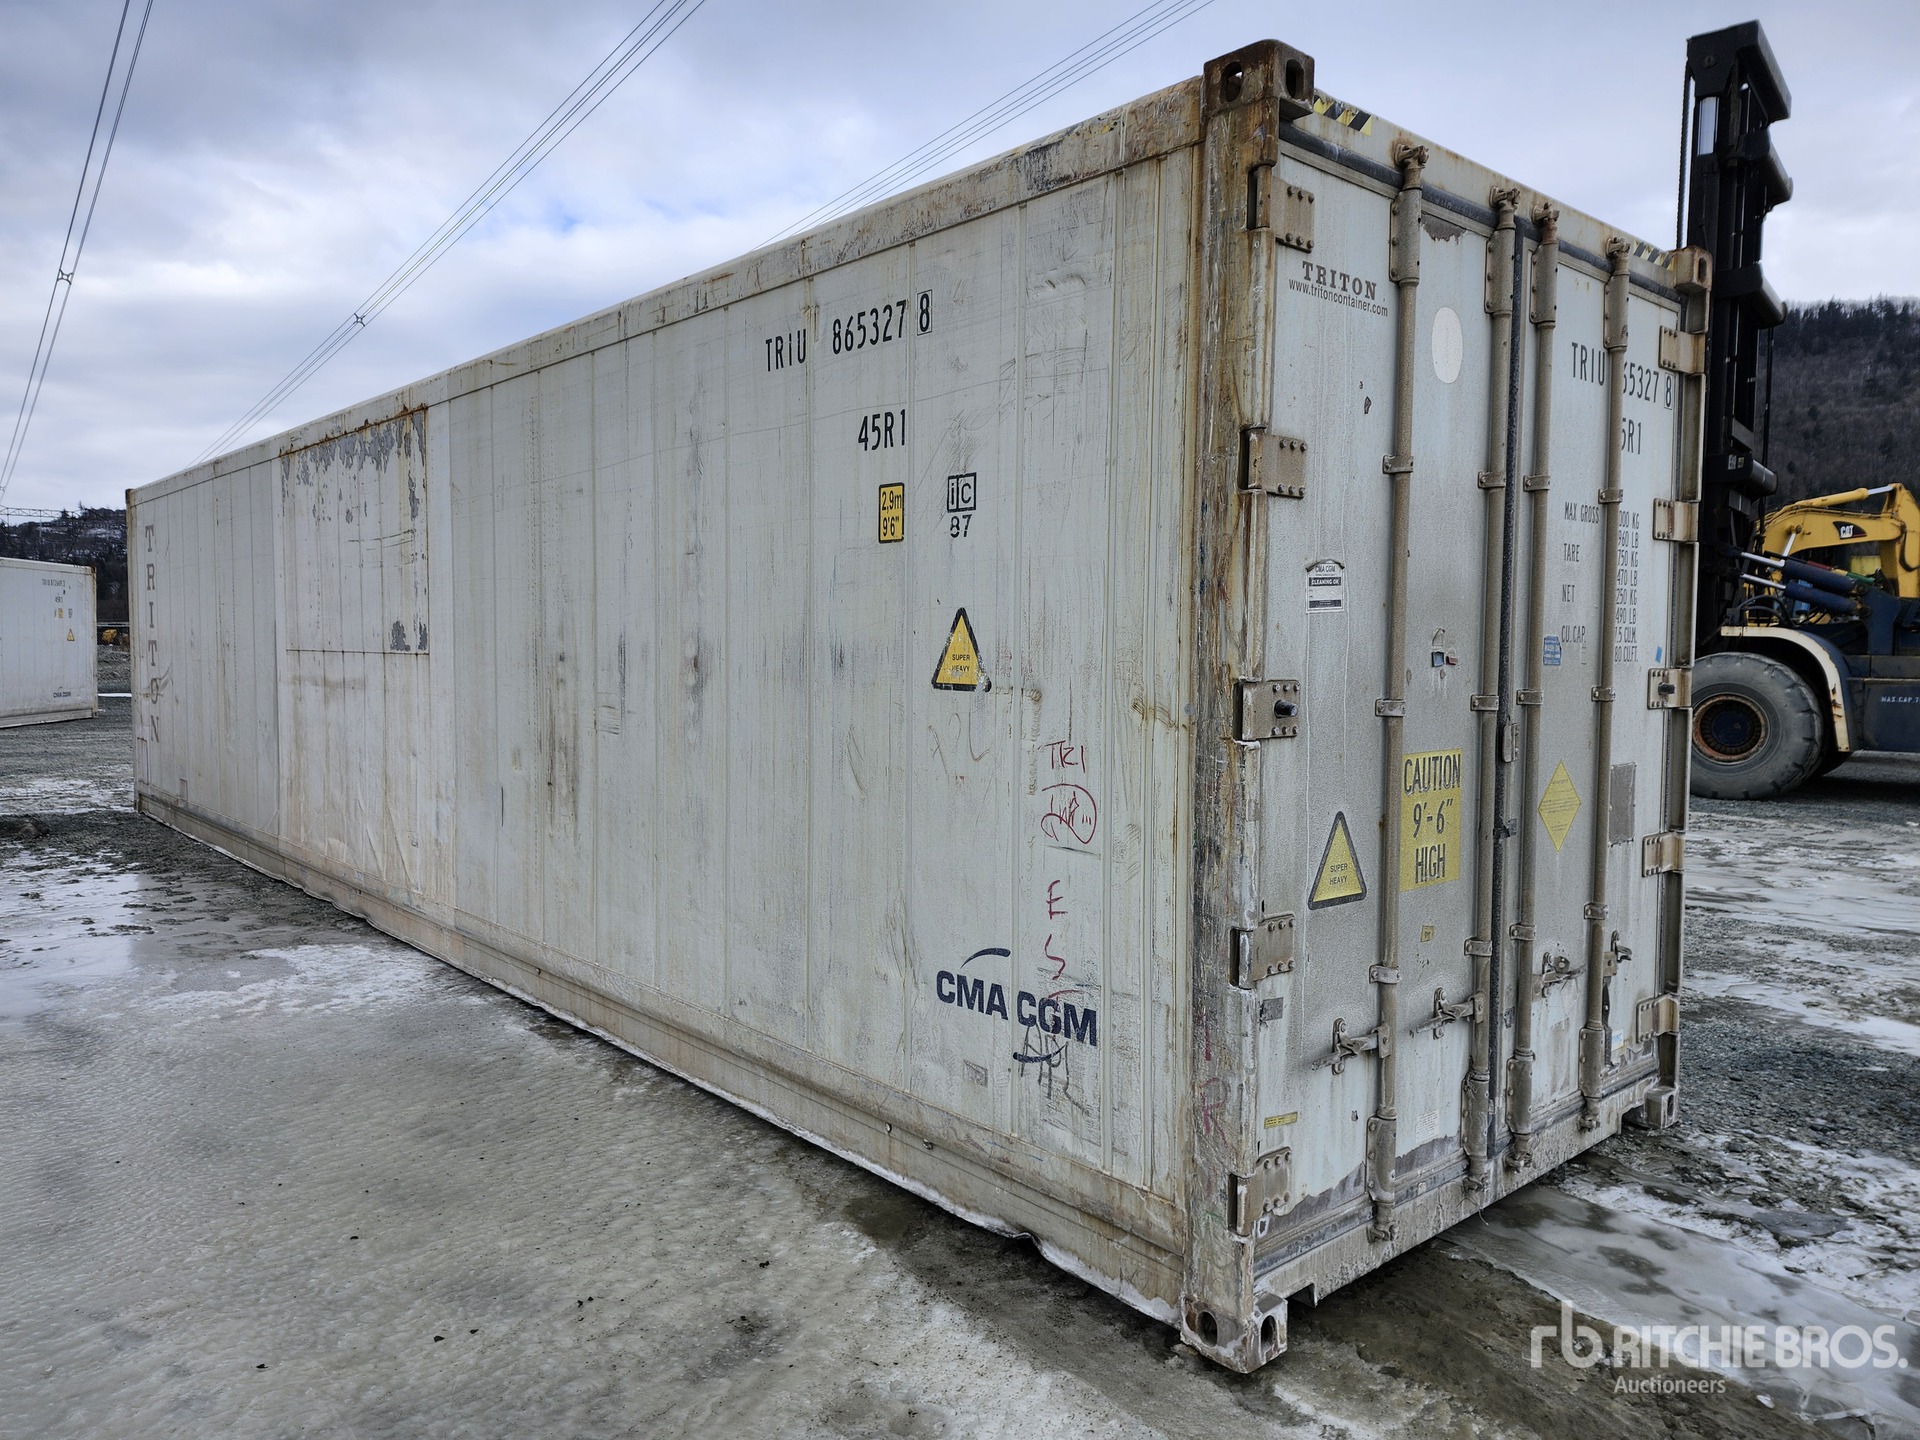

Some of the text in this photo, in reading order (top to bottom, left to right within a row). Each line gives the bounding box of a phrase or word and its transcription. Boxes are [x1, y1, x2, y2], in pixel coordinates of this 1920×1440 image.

[1288, 278, 1388, 317] www.tritoncontainer.com
[1302, 260, 1377, 301] TRITON
[765, 293, 930, 372] TRIU 865327 8
[1571, 341, 1606, 387] TRIU
[1622, 361, 1660, 403] 65327
[858, 408, 906, 451] 45R1
[1621, 417, 1642, 455] 5R1
[881, 490, 902, 514] 2,9m
[1564, 501, 1578, 521] MAX
[1580, 504, 1601, 525] GROSS
[882, 515, 900, 537] 9'6"
[1840, 525, 1854, 538] CAT
[1563, 543, 1580, 562] TARE
[1562, 584, 1575, 603] NET
[145, 524, 160, 743] TRITON
[952, 653, 970, 661] SUPER
[1404, 753, 1461, 796] CAUTION
[1330, 863, 1348, 873] SUPER
[1330, 876, 1348, 885] HEAVY
[1415, 843, 1446, 883] HIGH
[936, 970, 1009, 1021] CMA
[1017, 990, 1097, 1047] CGM
